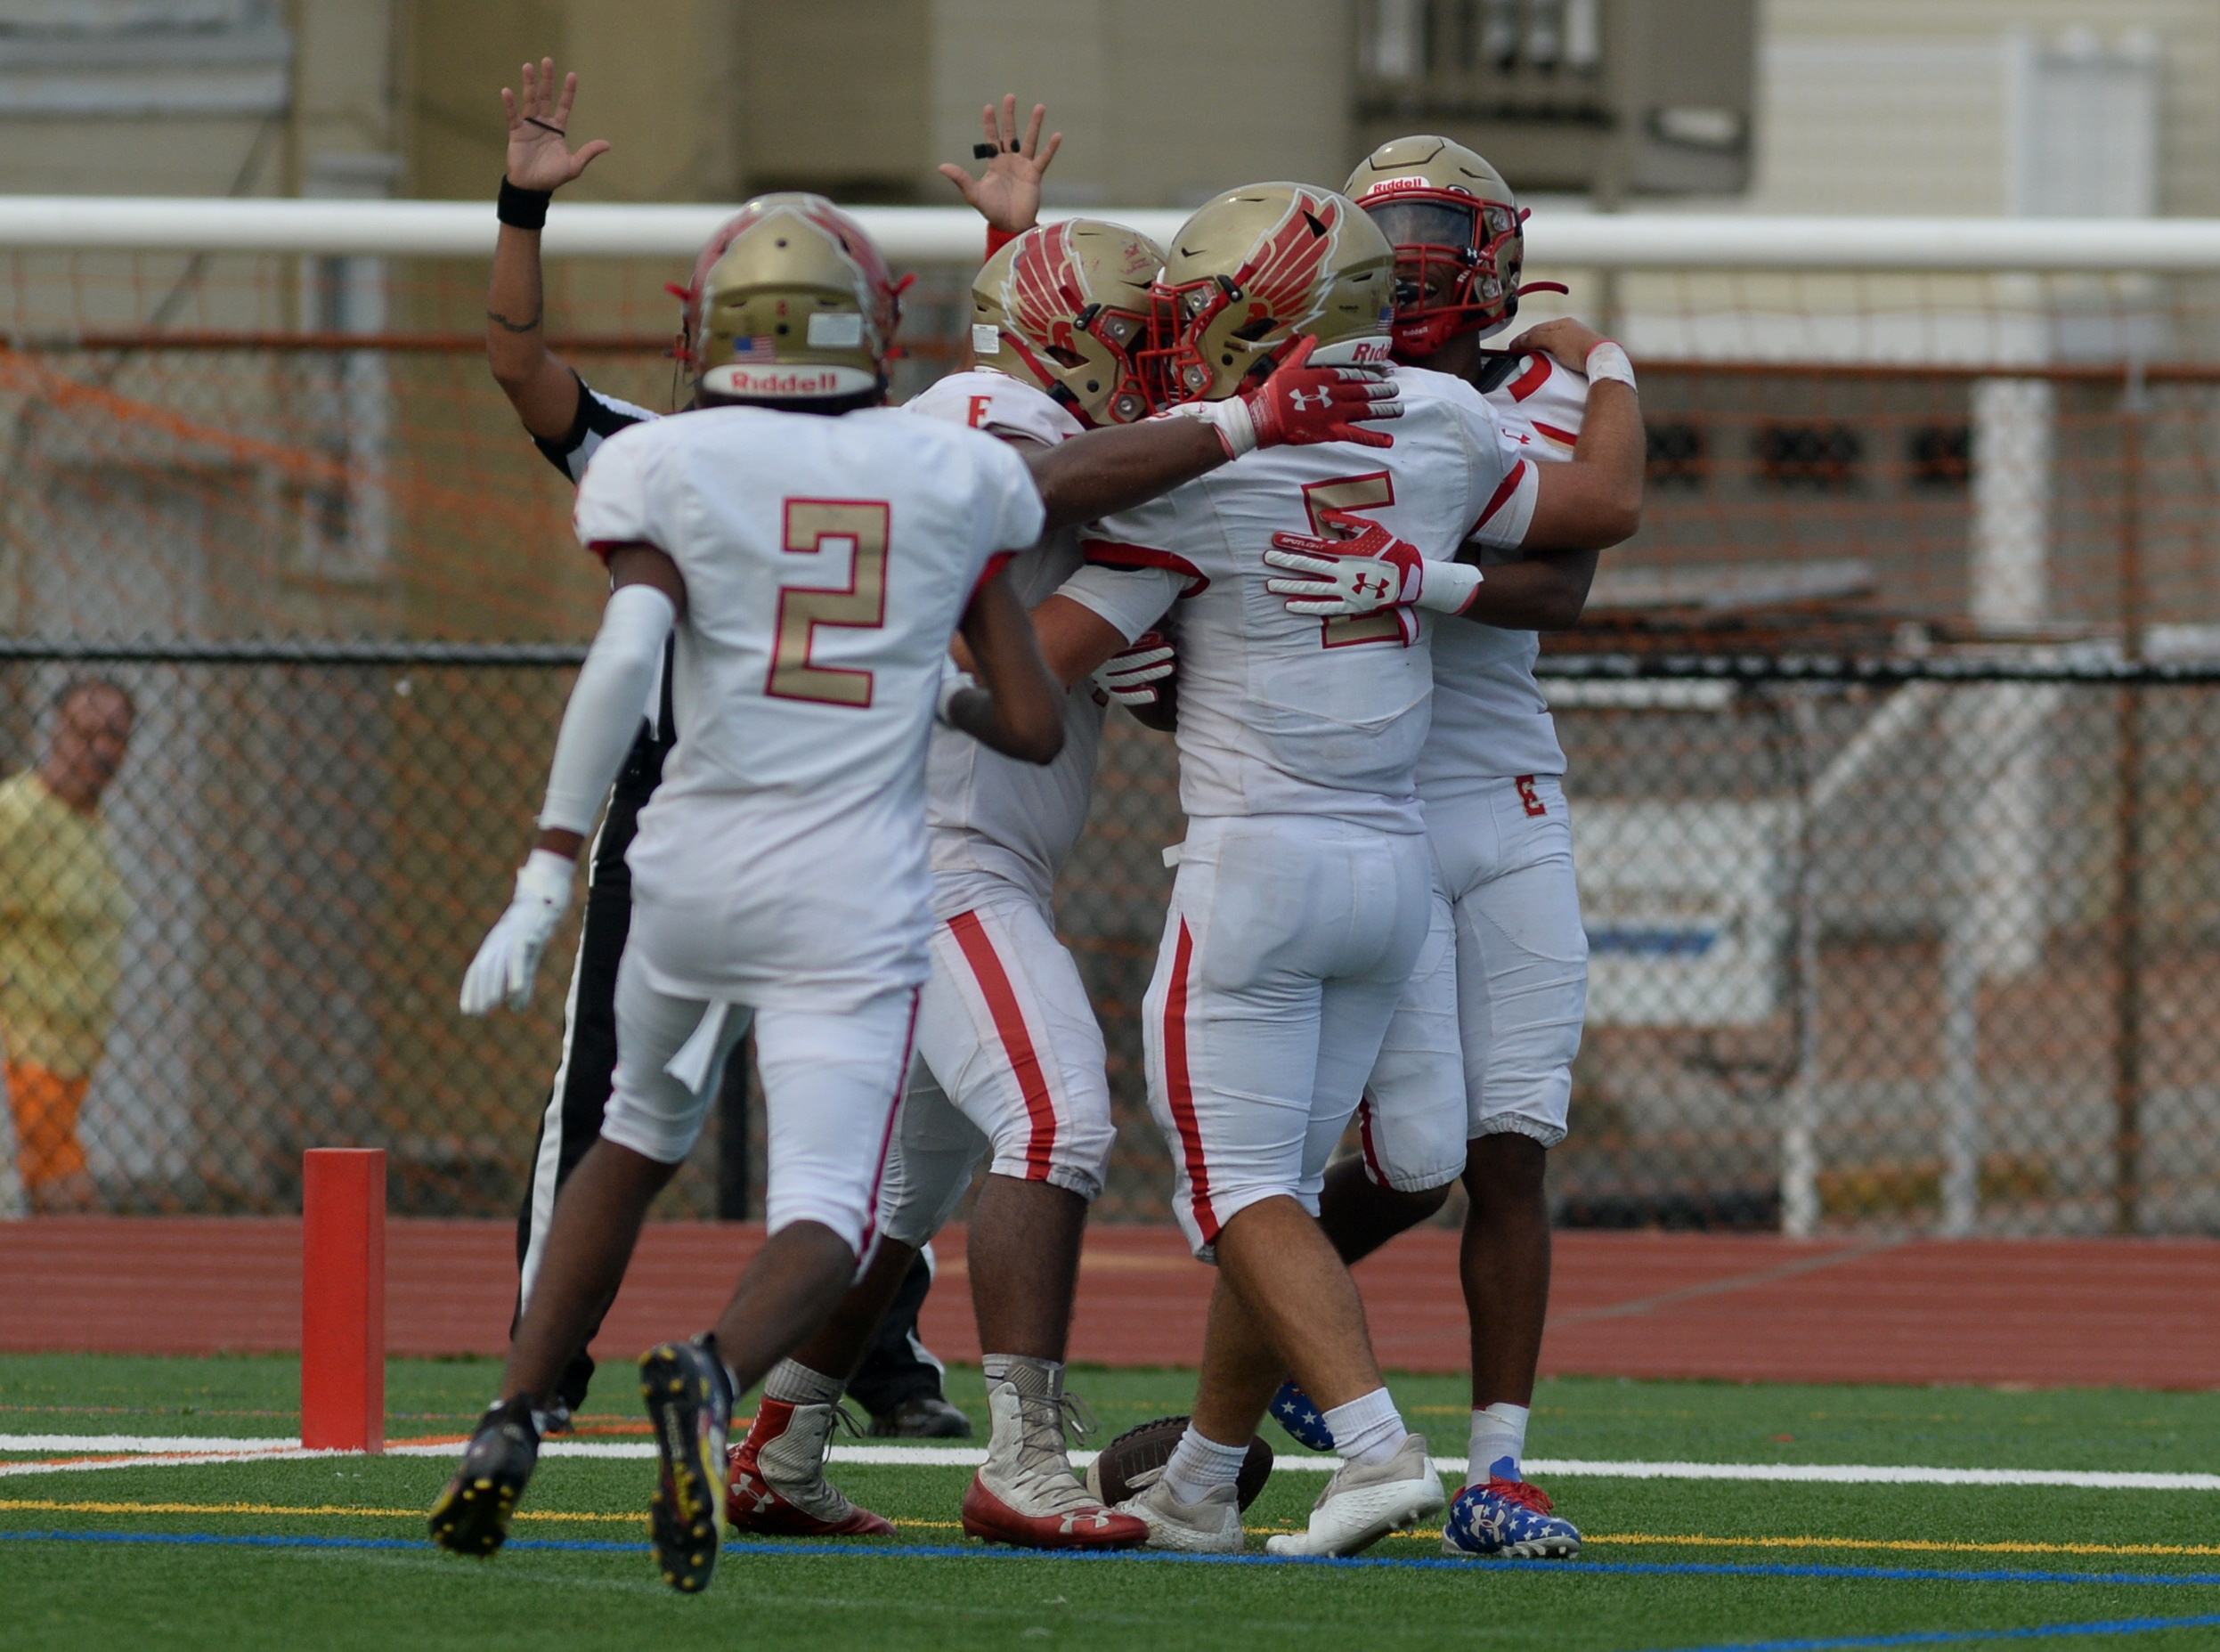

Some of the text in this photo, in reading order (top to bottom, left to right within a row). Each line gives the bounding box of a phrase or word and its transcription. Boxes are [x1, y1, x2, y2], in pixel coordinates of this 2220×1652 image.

[1373, 177, 1423, 194] Riddell
[1351, 342, 1392, 362] Ridd
[730, 371, 838, 393] Riddell
[1281, 536, 1326, 550] SPOTLIGHT
[764, 497, 890, 709] 2
[1515, 774, 1549, 818] E
